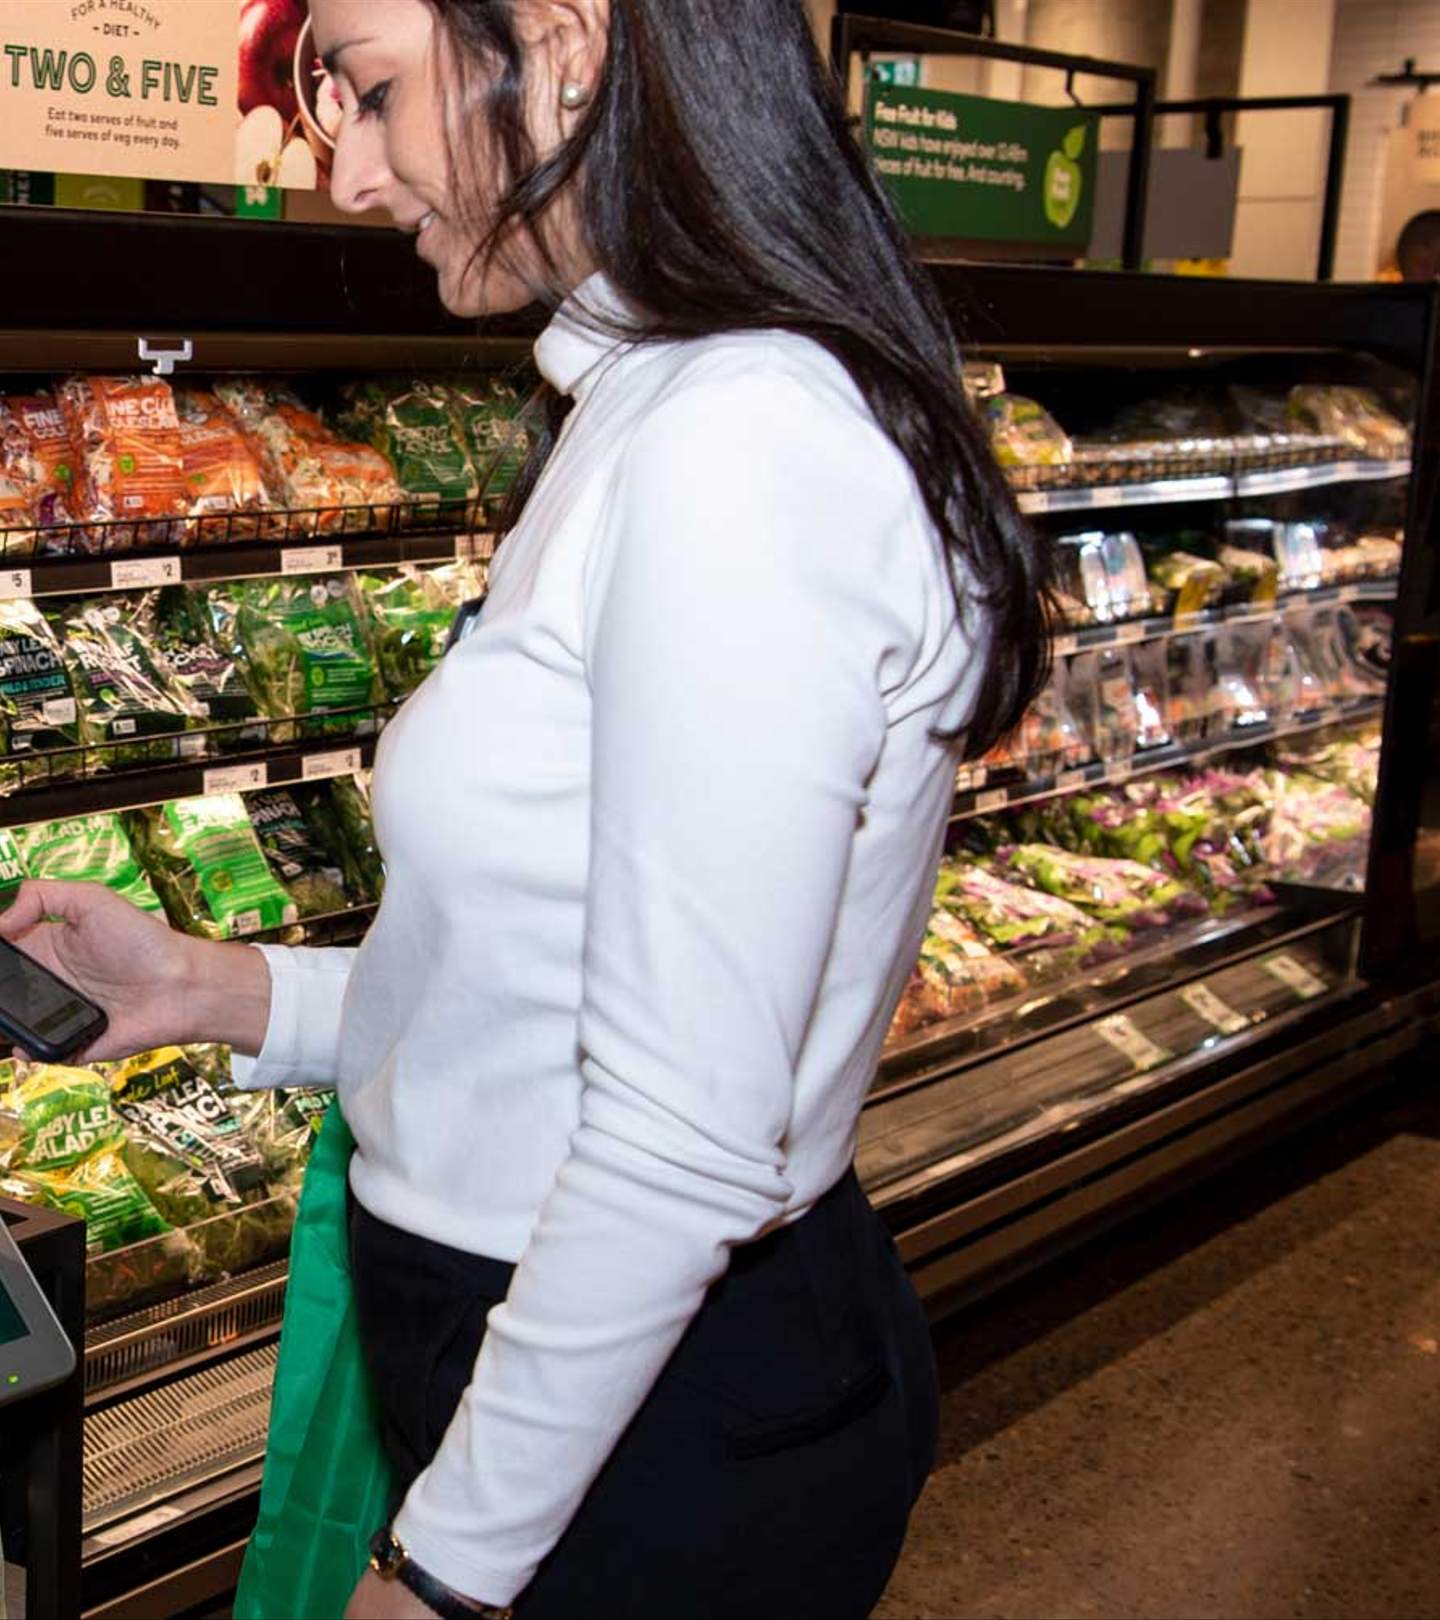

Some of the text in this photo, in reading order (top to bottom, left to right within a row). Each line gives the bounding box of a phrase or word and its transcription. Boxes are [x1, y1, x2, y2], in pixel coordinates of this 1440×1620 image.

[103, 23, 129, 37] DIET
[4, 44, 219, 106] TWO & FIVE
[47, 106, 66, 120] Eat
[68, 110, 88, 122] two
[90, 113, 122, 126] serves
[66, 128, 99, 141] serves
